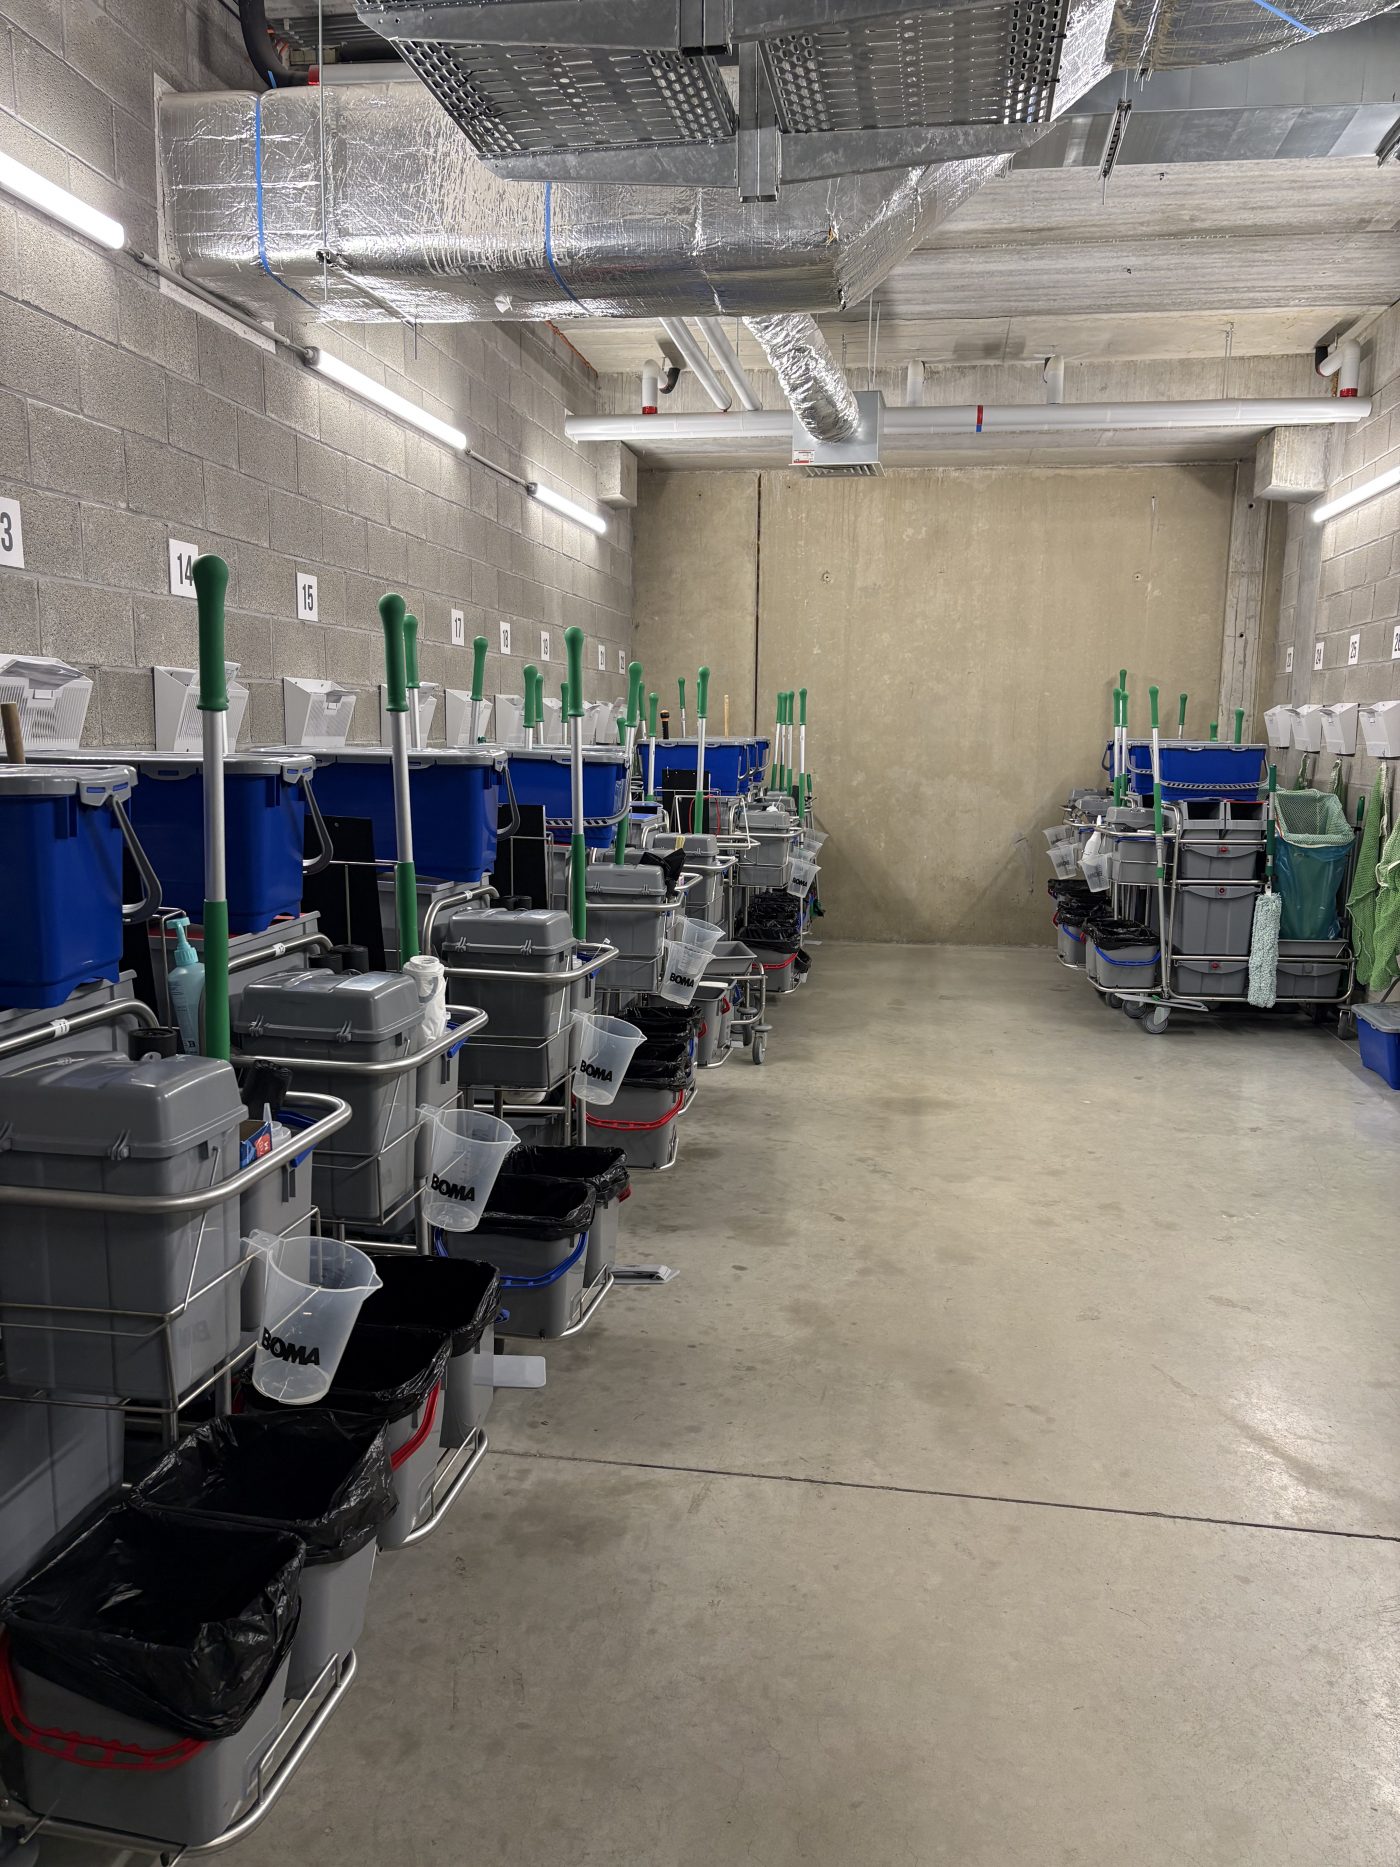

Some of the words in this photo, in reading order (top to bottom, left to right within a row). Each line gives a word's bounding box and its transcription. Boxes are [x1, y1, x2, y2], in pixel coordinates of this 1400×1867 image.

[0, 511, 14, 552] 3
[177, 552, 194, 587] 14
[302, 583, 314, 612] 15
[454, 617, 462, 639] 17
[669, 972, 696, 989] BOMA
[579, 1059, 613, 1083] BOMA
[430, 1173, 476, 1202] BOMA
[261, 1327, 321, 1366] BOMA
